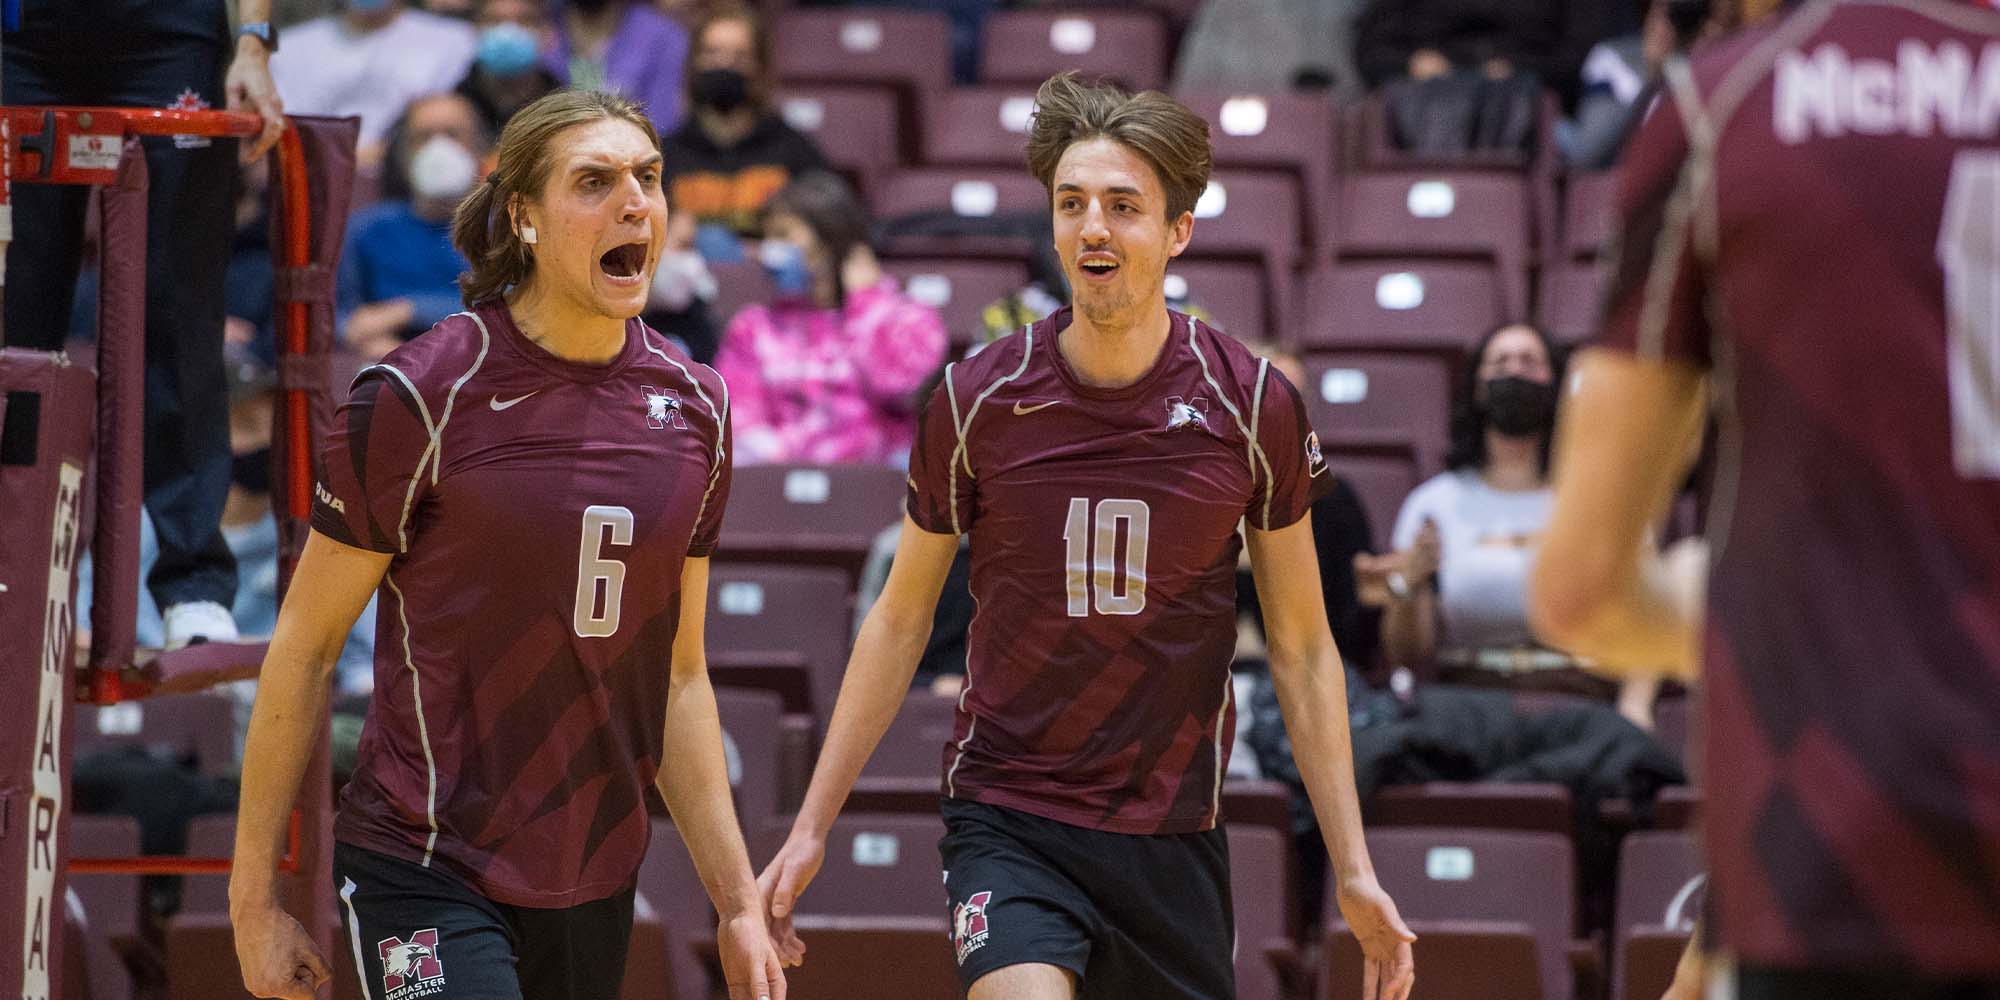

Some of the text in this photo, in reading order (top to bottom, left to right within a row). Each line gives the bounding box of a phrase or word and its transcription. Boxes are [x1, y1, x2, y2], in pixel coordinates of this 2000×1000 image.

[573, 504, 634, 638] 6
[1062, 497, 1150, 617] 10
[26, 599, 69, 1000] MARA
[385, 977, 446, 1000] McMASTER
